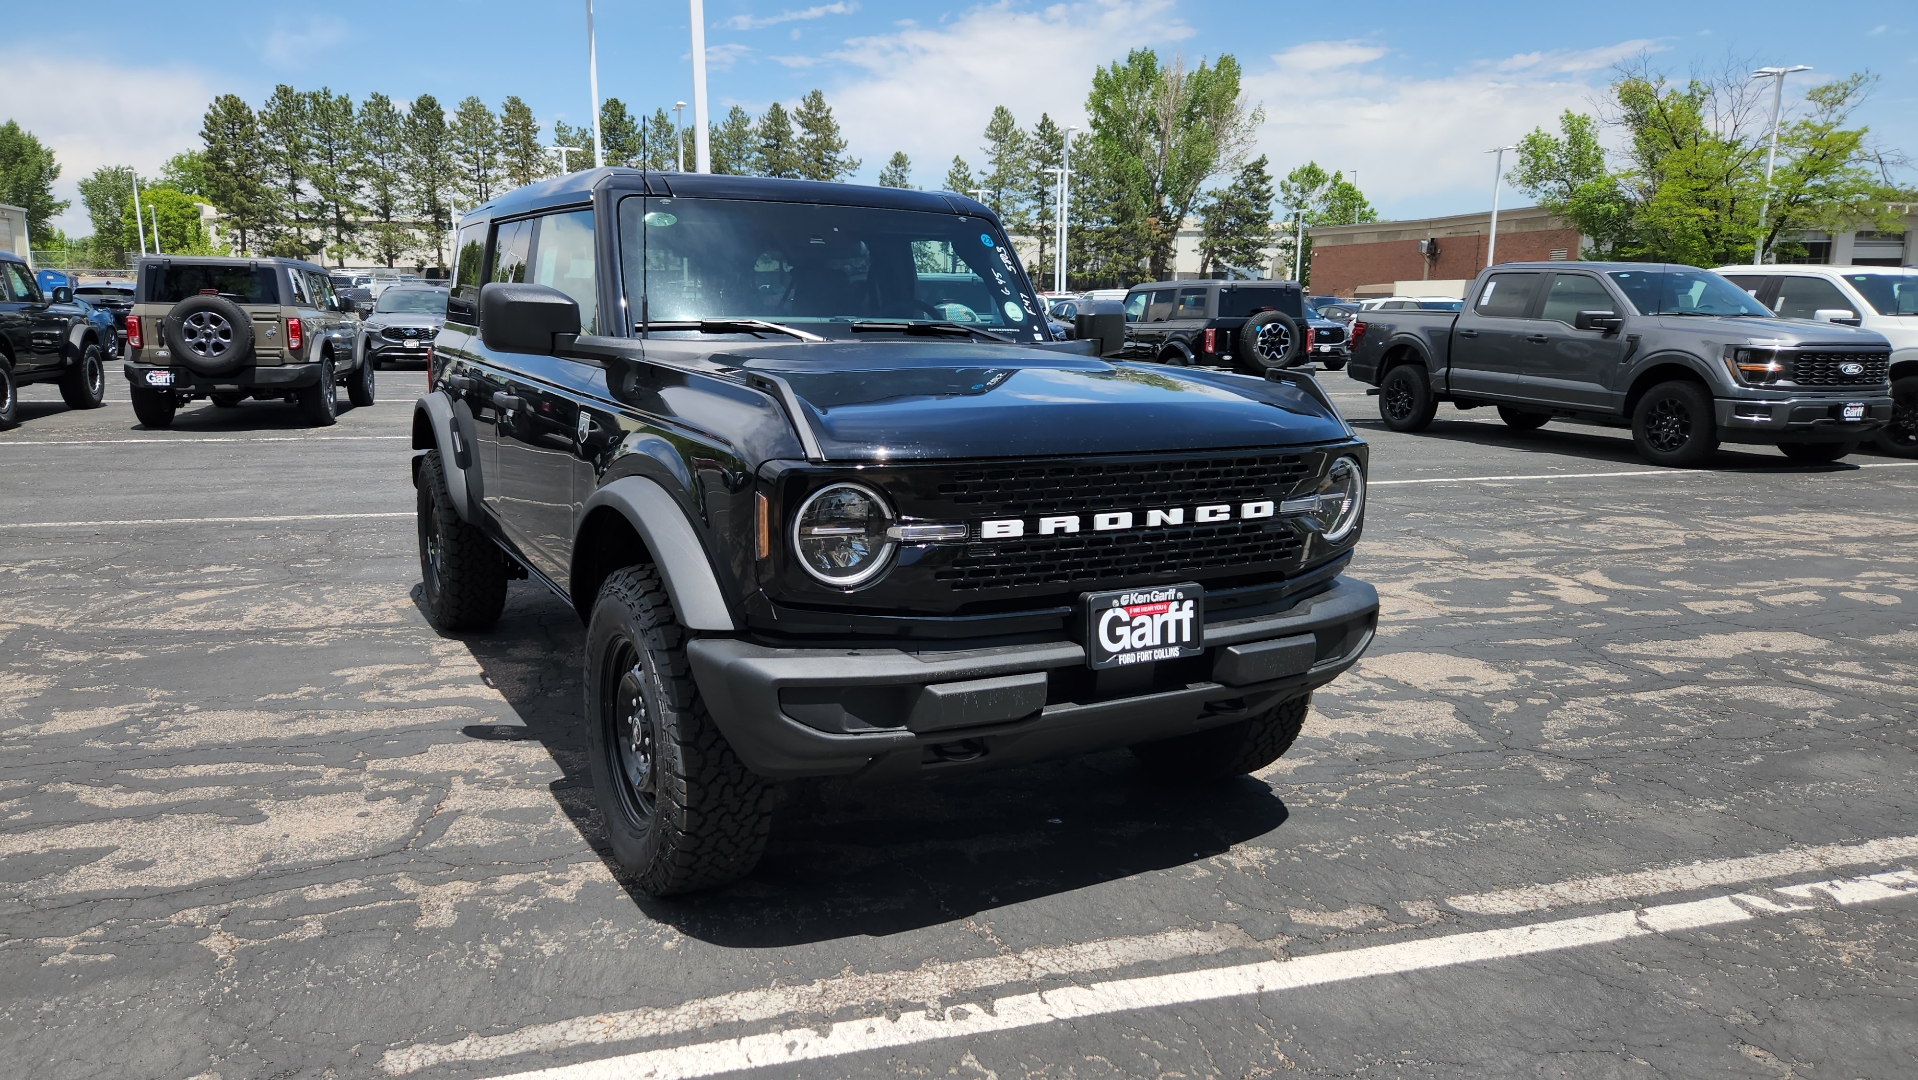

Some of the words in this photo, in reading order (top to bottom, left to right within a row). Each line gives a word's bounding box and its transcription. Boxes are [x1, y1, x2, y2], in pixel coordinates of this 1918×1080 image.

[146, 372, 175, 383] Garff
[1844, 406, 1864, 417] Garff
[981, 501, 1274, 538] BRONCO
[1130, 592, 1150, 604] Ken
[1151, 589, 1176, 602] Garff
[1099, 600, 1193, 652] Garff
[1118, 654, 1136, 664] FORD
[1136, 650, 1153, 662] FORT
[1154, 646, 1180, 660] COLLINS
